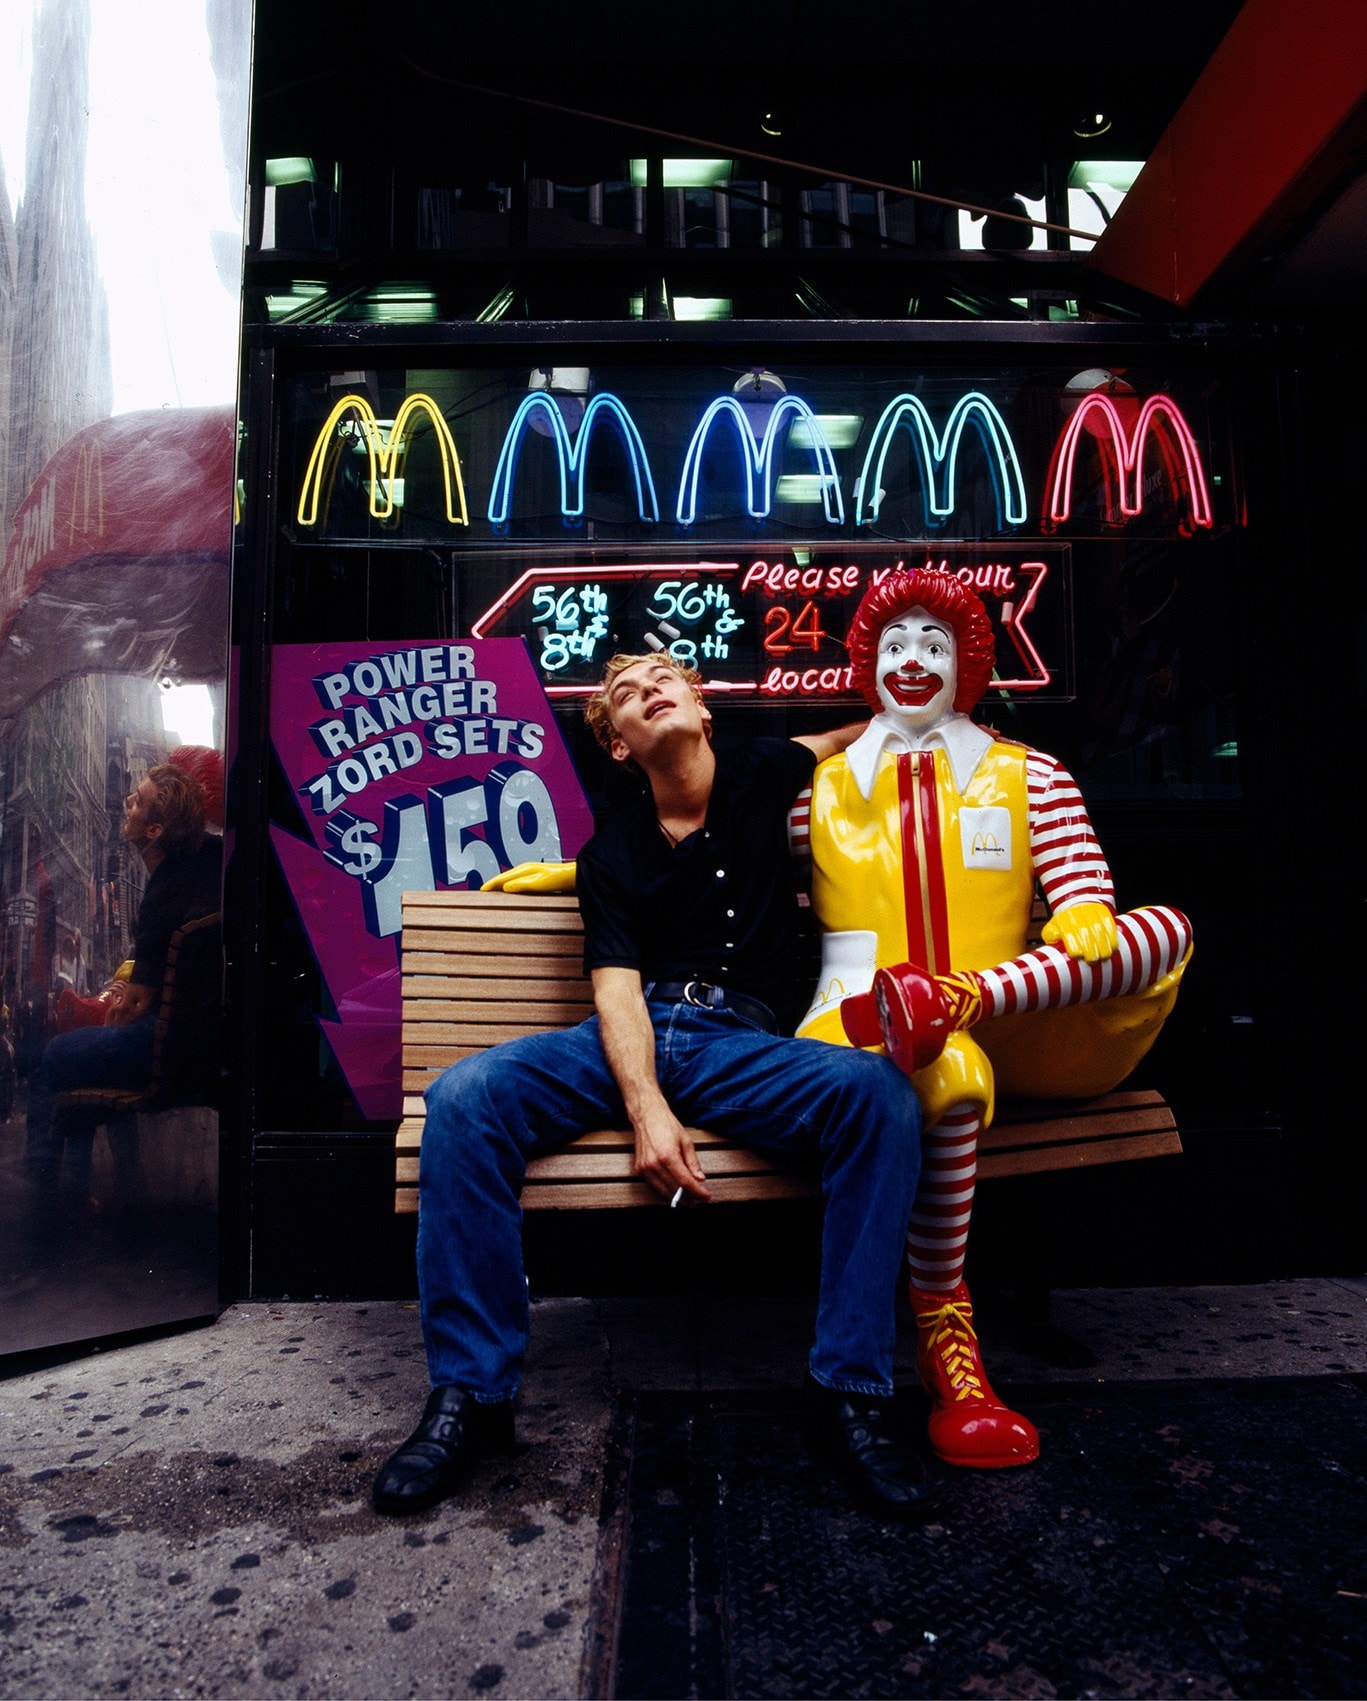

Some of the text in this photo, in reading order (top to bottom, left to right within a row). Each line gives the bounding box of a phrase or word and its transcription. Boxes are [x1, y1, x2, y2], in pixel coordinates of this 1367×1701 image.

[741, 561, 860, 593] Please
[956, 564, 1016, 589] our
[531, 583, 608, 622] 56th
[645, 580, 730, 620] 56th
[715, 608, 745, 634] &
[763, 600, 828, 652] 24
[540, 629, 597, 670] 8th
[314, 644, 476, 711] POWER
[309, 680, 498, 758] RANGER
[298, 715, 546, 816] ZORD SETS
